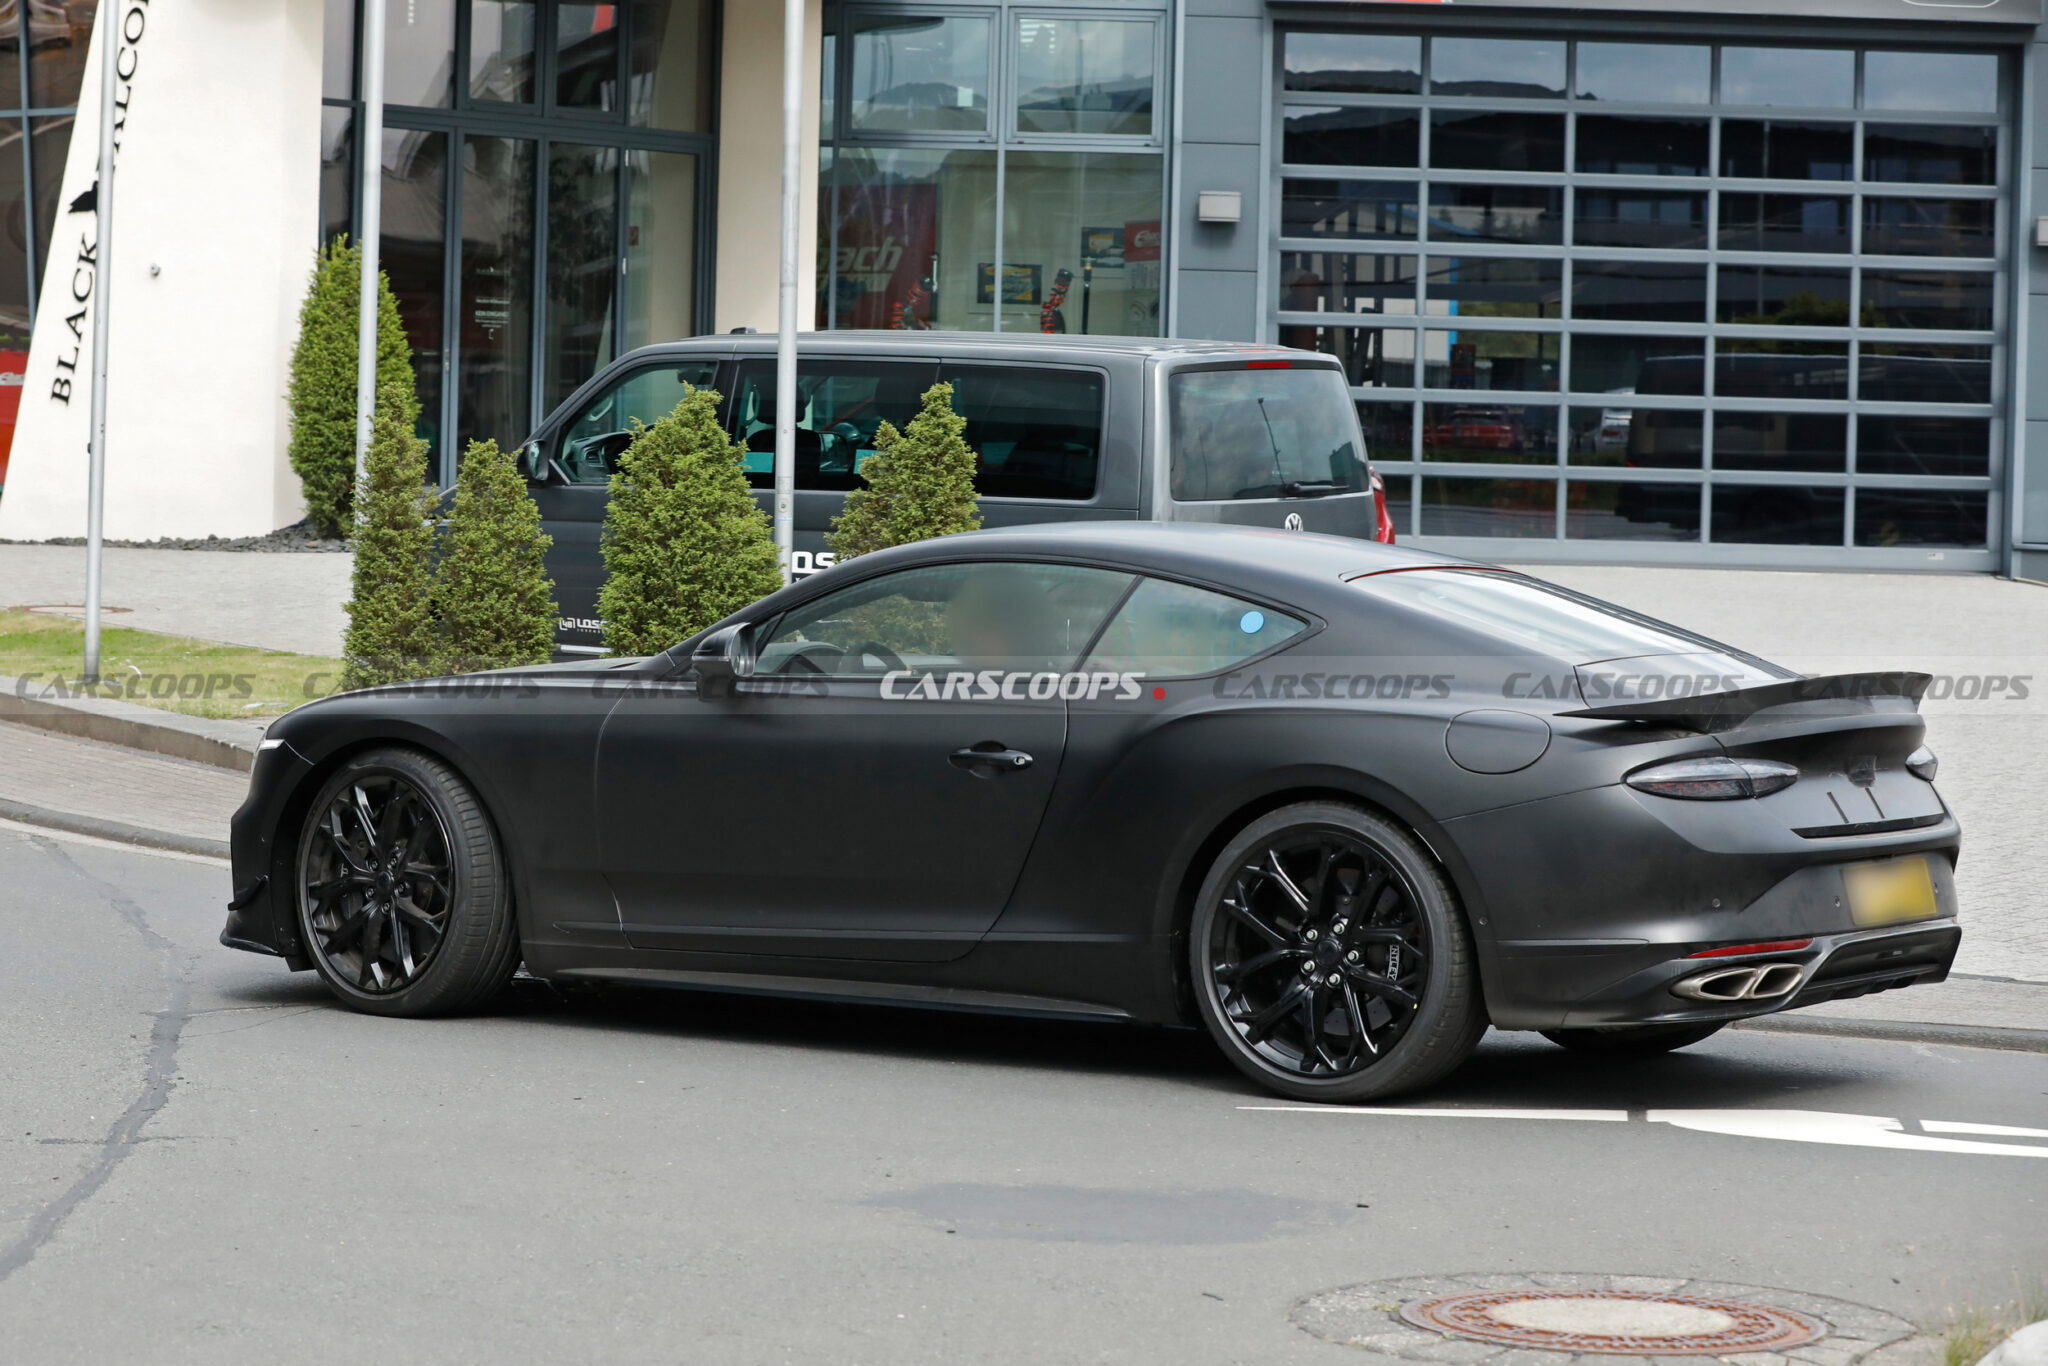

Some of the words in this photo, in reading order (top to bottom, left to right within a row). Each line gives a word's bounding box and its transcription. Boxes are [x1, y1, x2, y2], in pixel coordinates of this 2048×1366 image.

[51, 233, 97, 406] BLACK
[96, 0, 149, 172] LCO
[791, 551, 840, 574] OS
[1388, 945, 1399, 980] NTLEY
